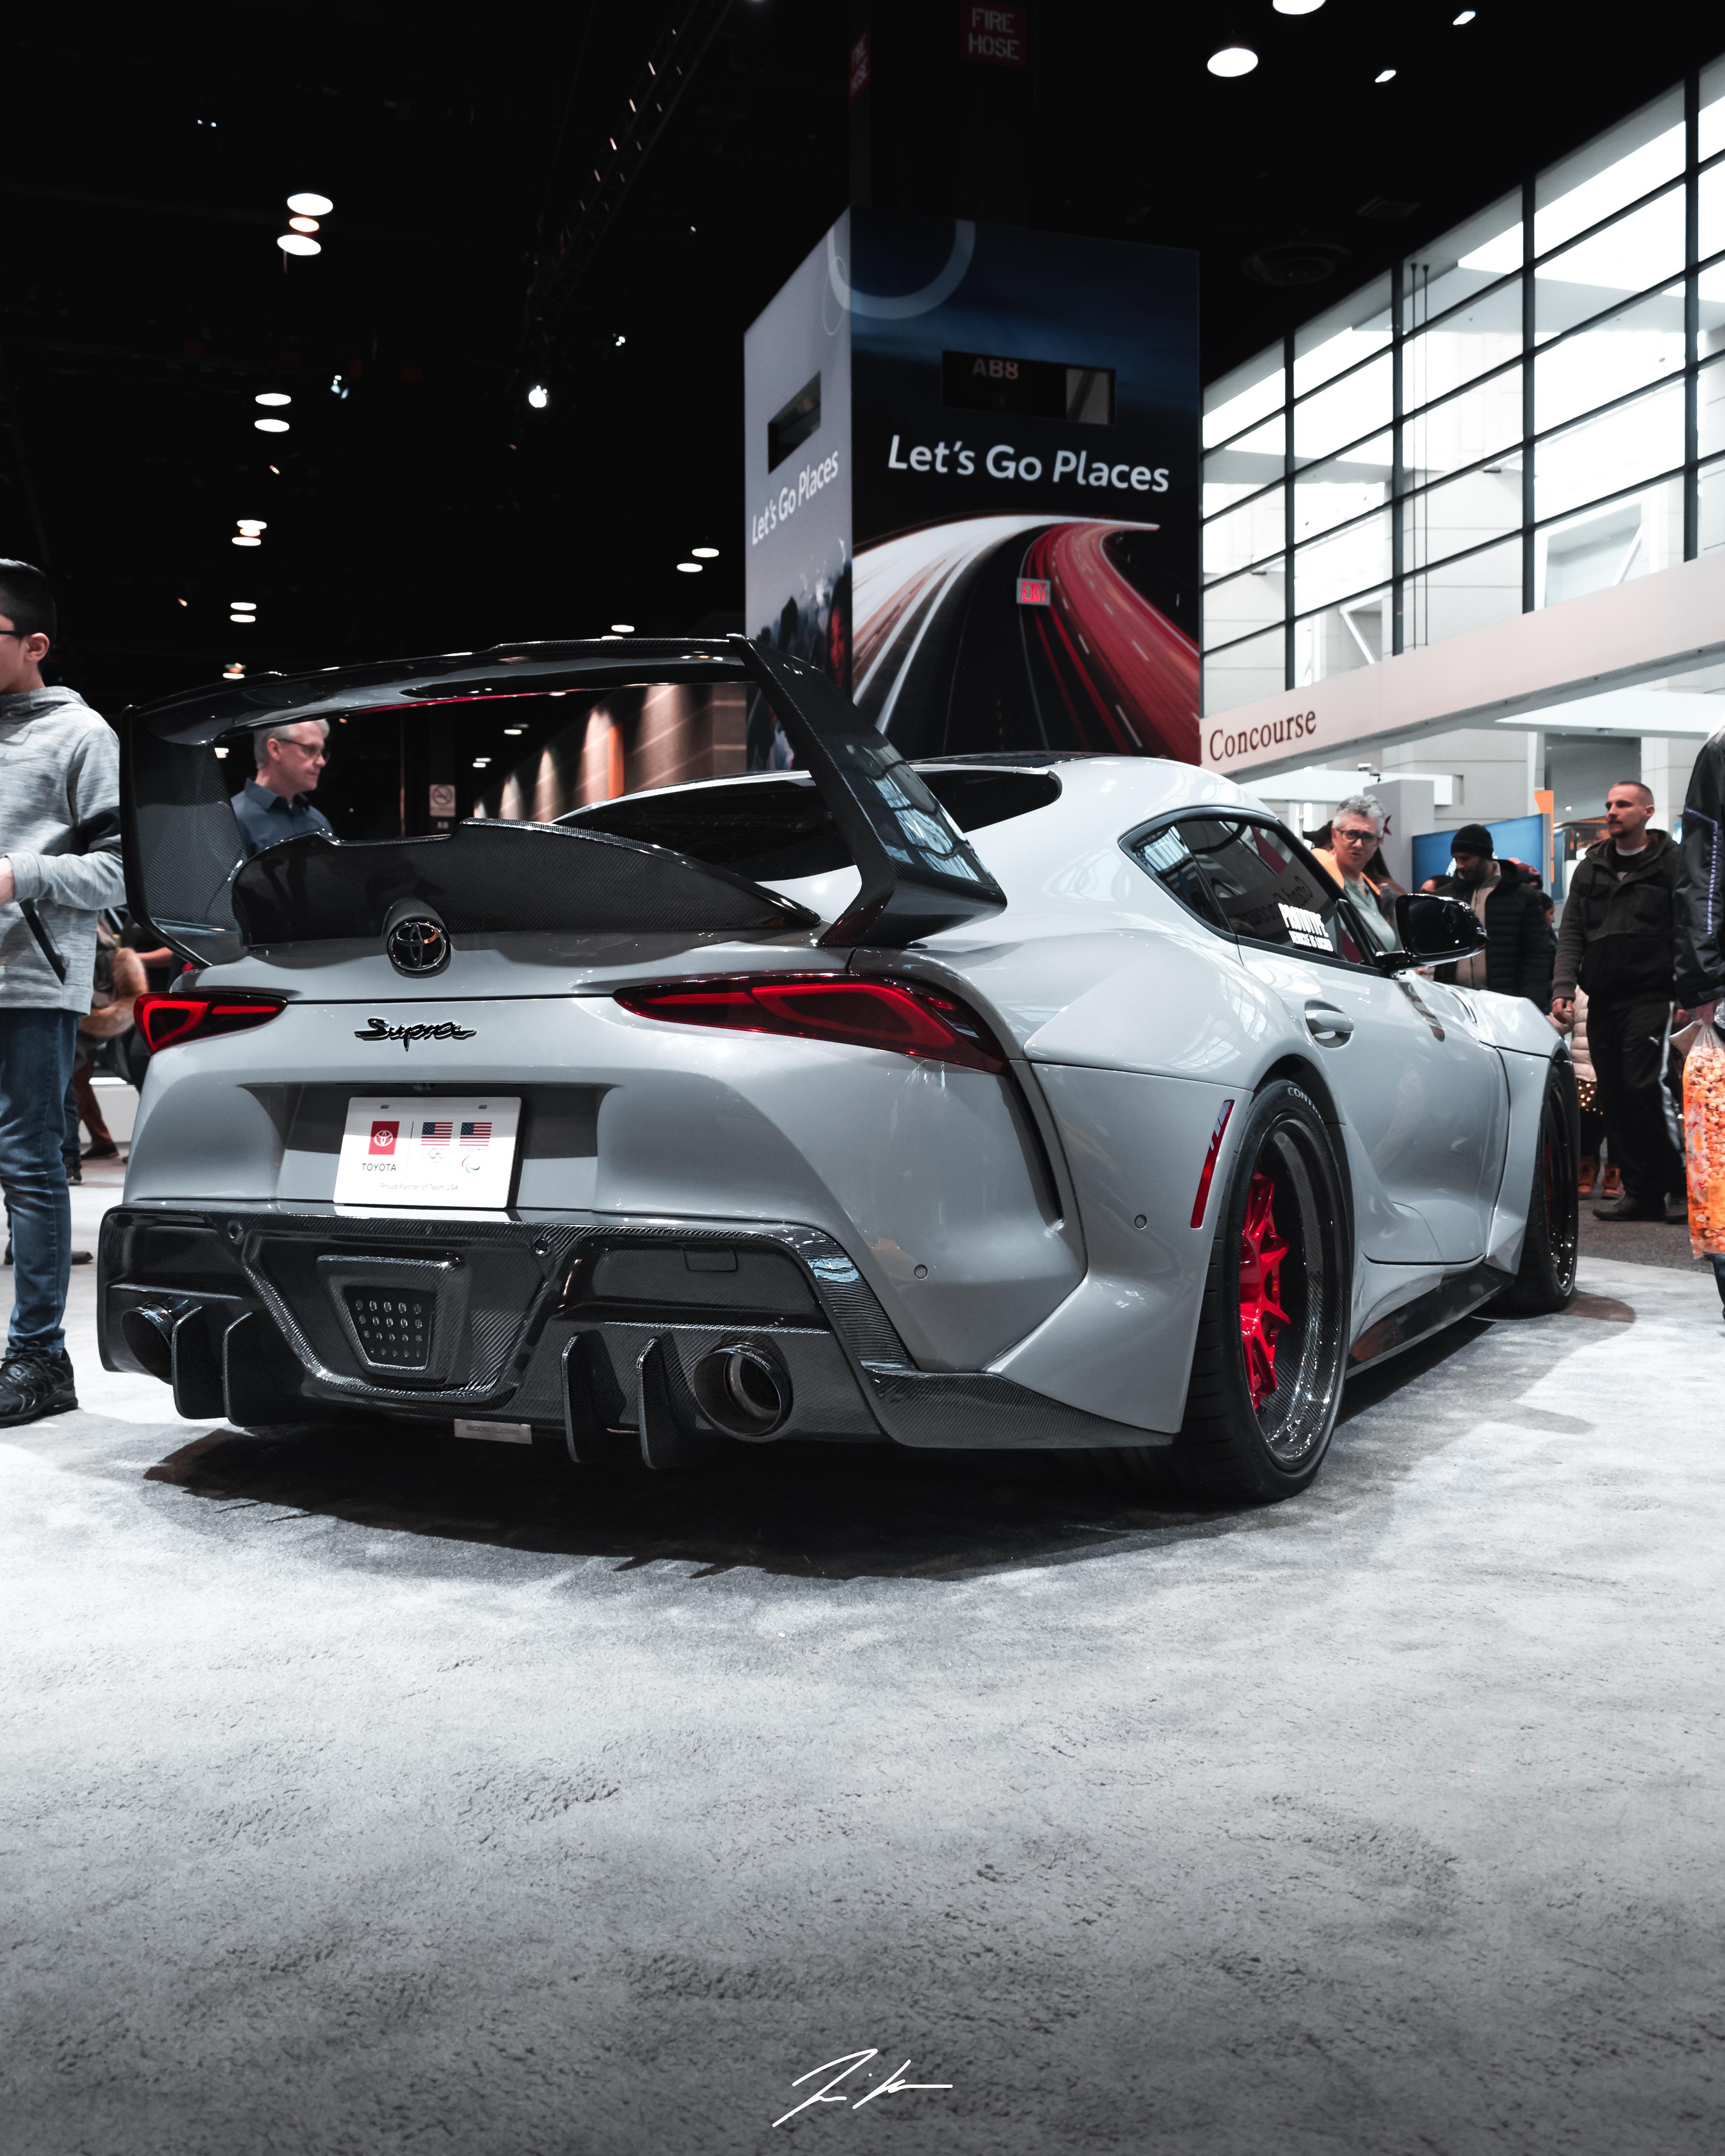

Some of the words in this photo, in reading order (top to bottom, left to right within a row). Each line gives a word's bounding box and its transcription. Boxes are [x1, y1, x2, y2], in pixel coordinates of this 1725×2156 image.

[972, 7, 1014, 34] FIRE
[968, 32, 1019, 60] HOSE
[972, 359, 1019, 379] AB8
[888, 434, 975, 476] Let's
[986, 445, 1042, 481] Go
[1053, 450, 1169, 492] Places
[752, 499, 777, 546] Let's
[778, 486, 796, 522] Go
[798, 450, 838, 507] Places
[1022, 581, 1046, 603] EXIT
[1210, 710, 1316, 761] Concourse
[1278, 903, 1329, 938] PROTOTYPE
[354, 1017, 477, 1052] Supra
[362, 1163, 397, 1172] TOYOTA
